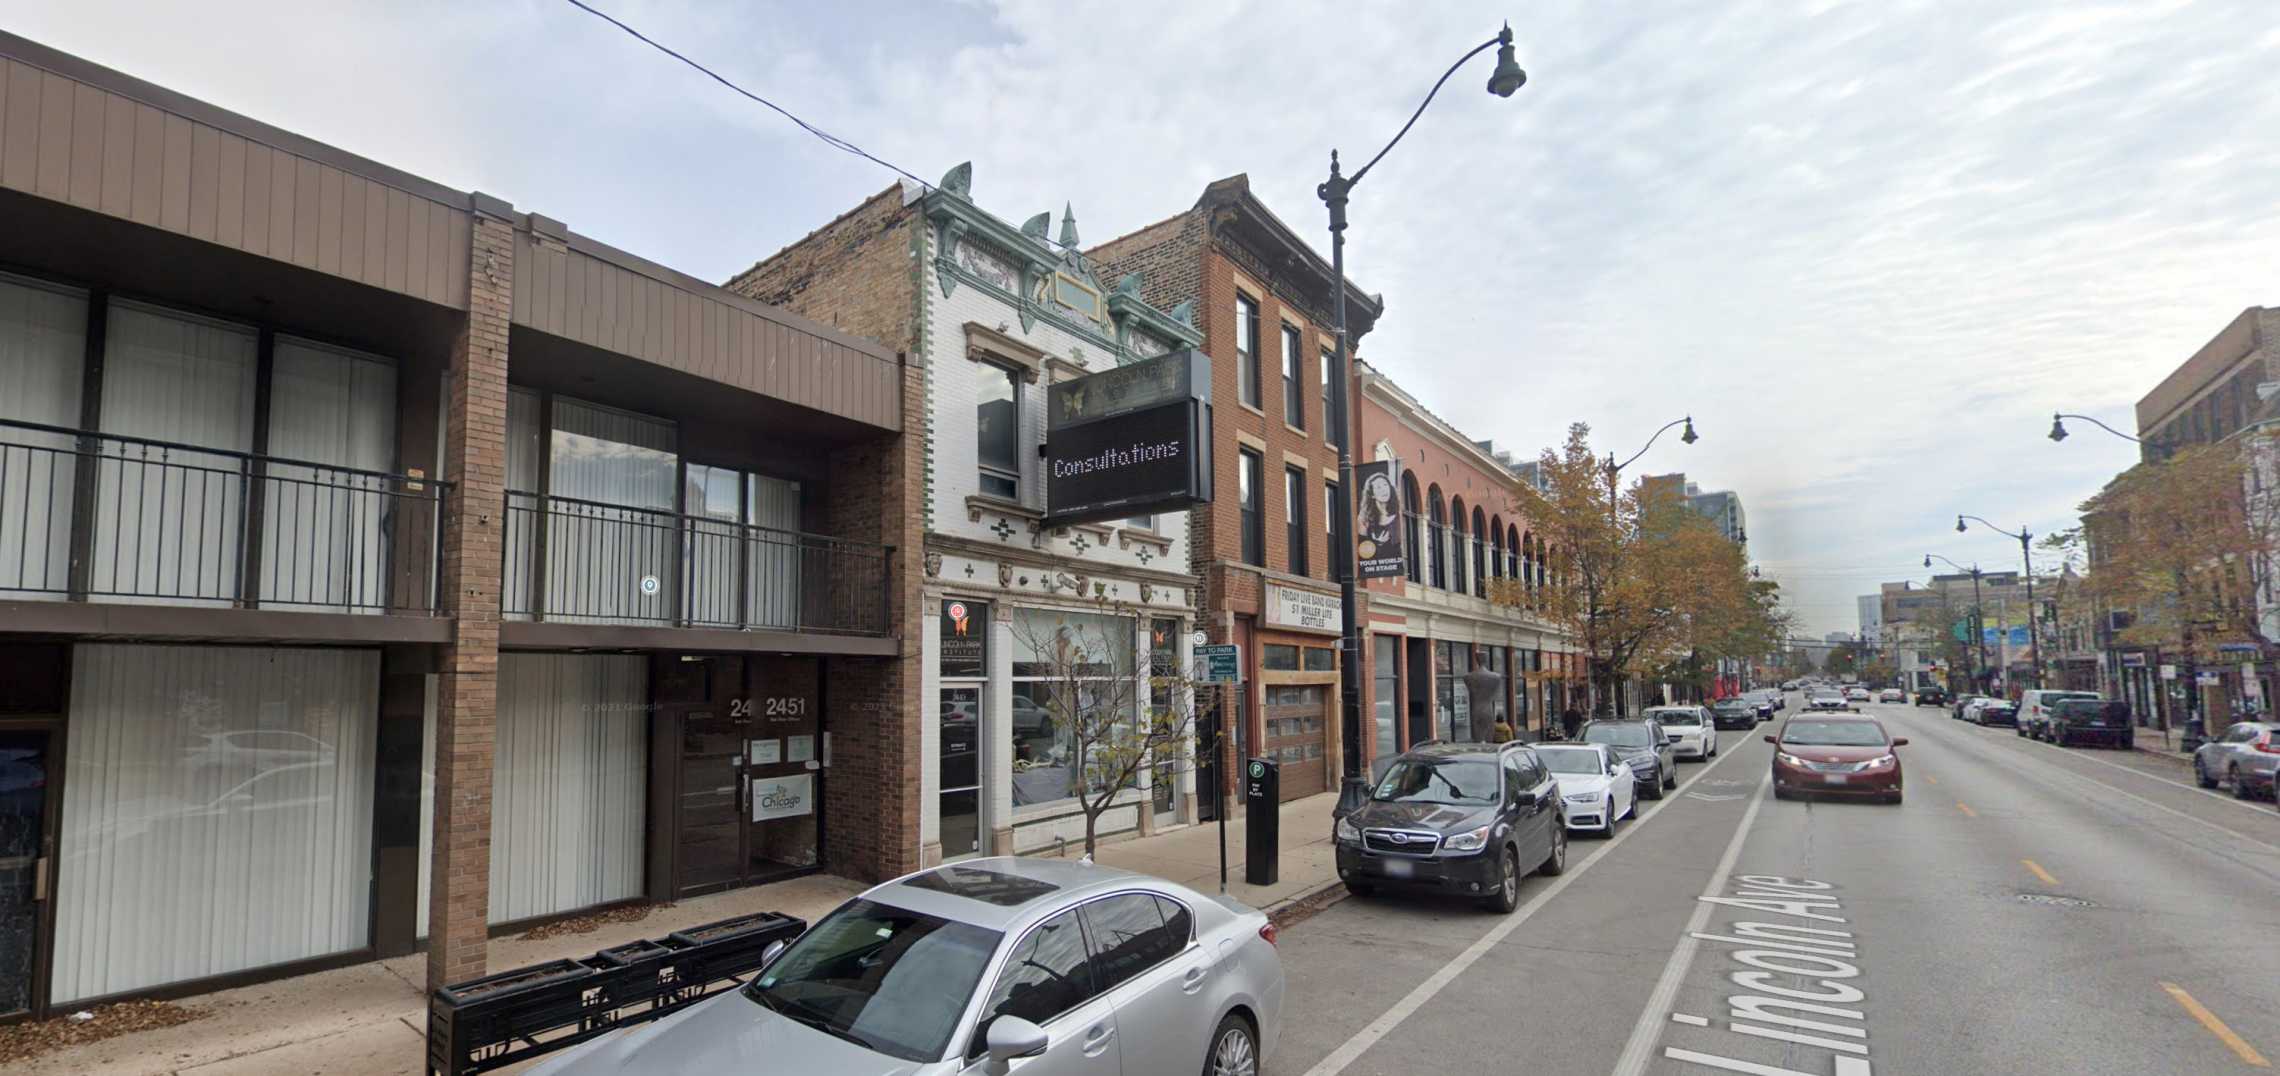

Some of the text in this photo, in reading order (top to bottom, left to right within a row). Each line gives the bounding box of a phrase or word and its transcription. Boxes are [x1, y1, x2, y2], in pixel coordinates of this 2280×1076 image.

[1054, 441, 1180, 478] Consultations
[1359, 557, 1402, 567] YOUR WORLD
[1376, 564, 1398, 572] STAGE
[1282, 589, 1300, 603] FRIDAY
[1301, 592, 1311, 605] LIVE
[1312, 594, 1325, 607] BAND
[1301, 605, 1321, 617] MILLER
[1322, 609, 1332, 619] LITE
[1301, 615, 1325, 628] BOTTLES
[766, 697, 806, 715] 2451
[761, 795, 801, 809] Chicago
